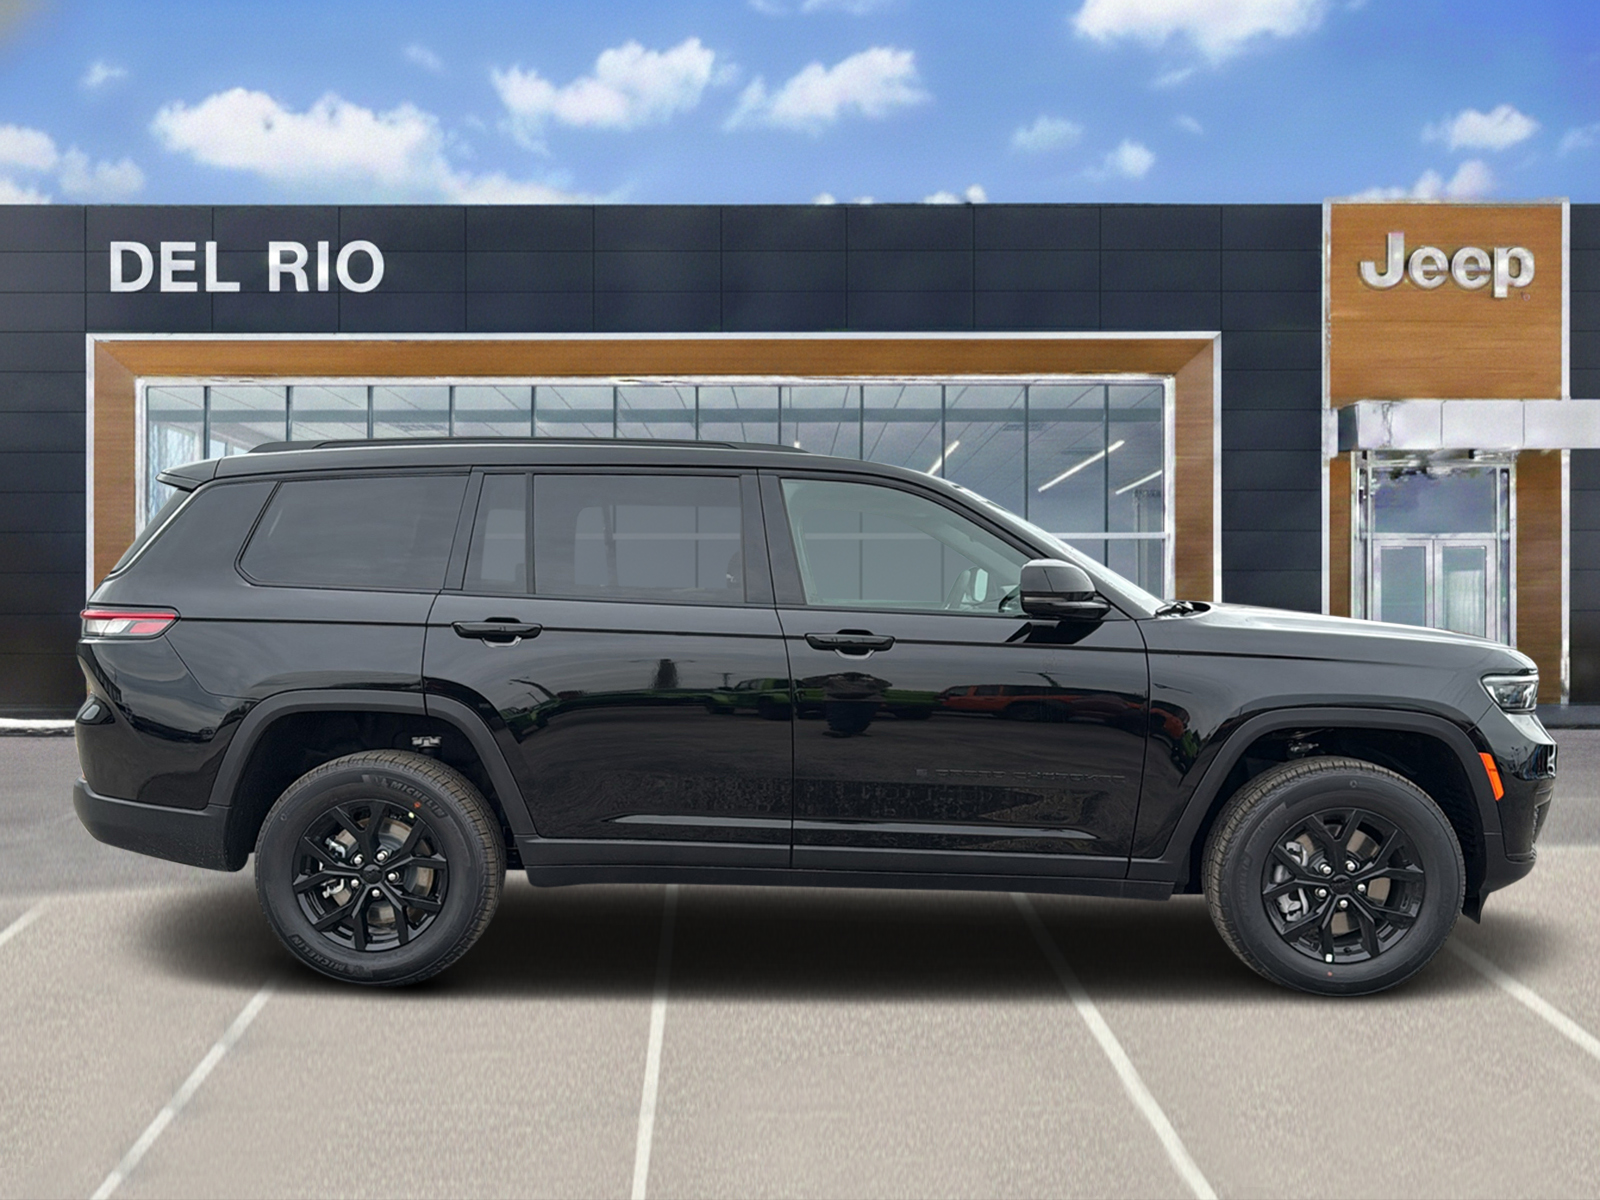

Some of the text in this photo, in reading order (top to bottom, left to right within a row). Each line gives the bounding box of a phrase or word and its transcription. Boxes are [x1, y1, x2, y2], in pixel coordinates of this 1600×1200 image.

[109, 239, 385, 293] DEL RIO
[1359, 231, 1536, 299] Jeep
[390, 780, 446, 817] MICHELIN
[291, 935, 347, 972] MICHELIN
